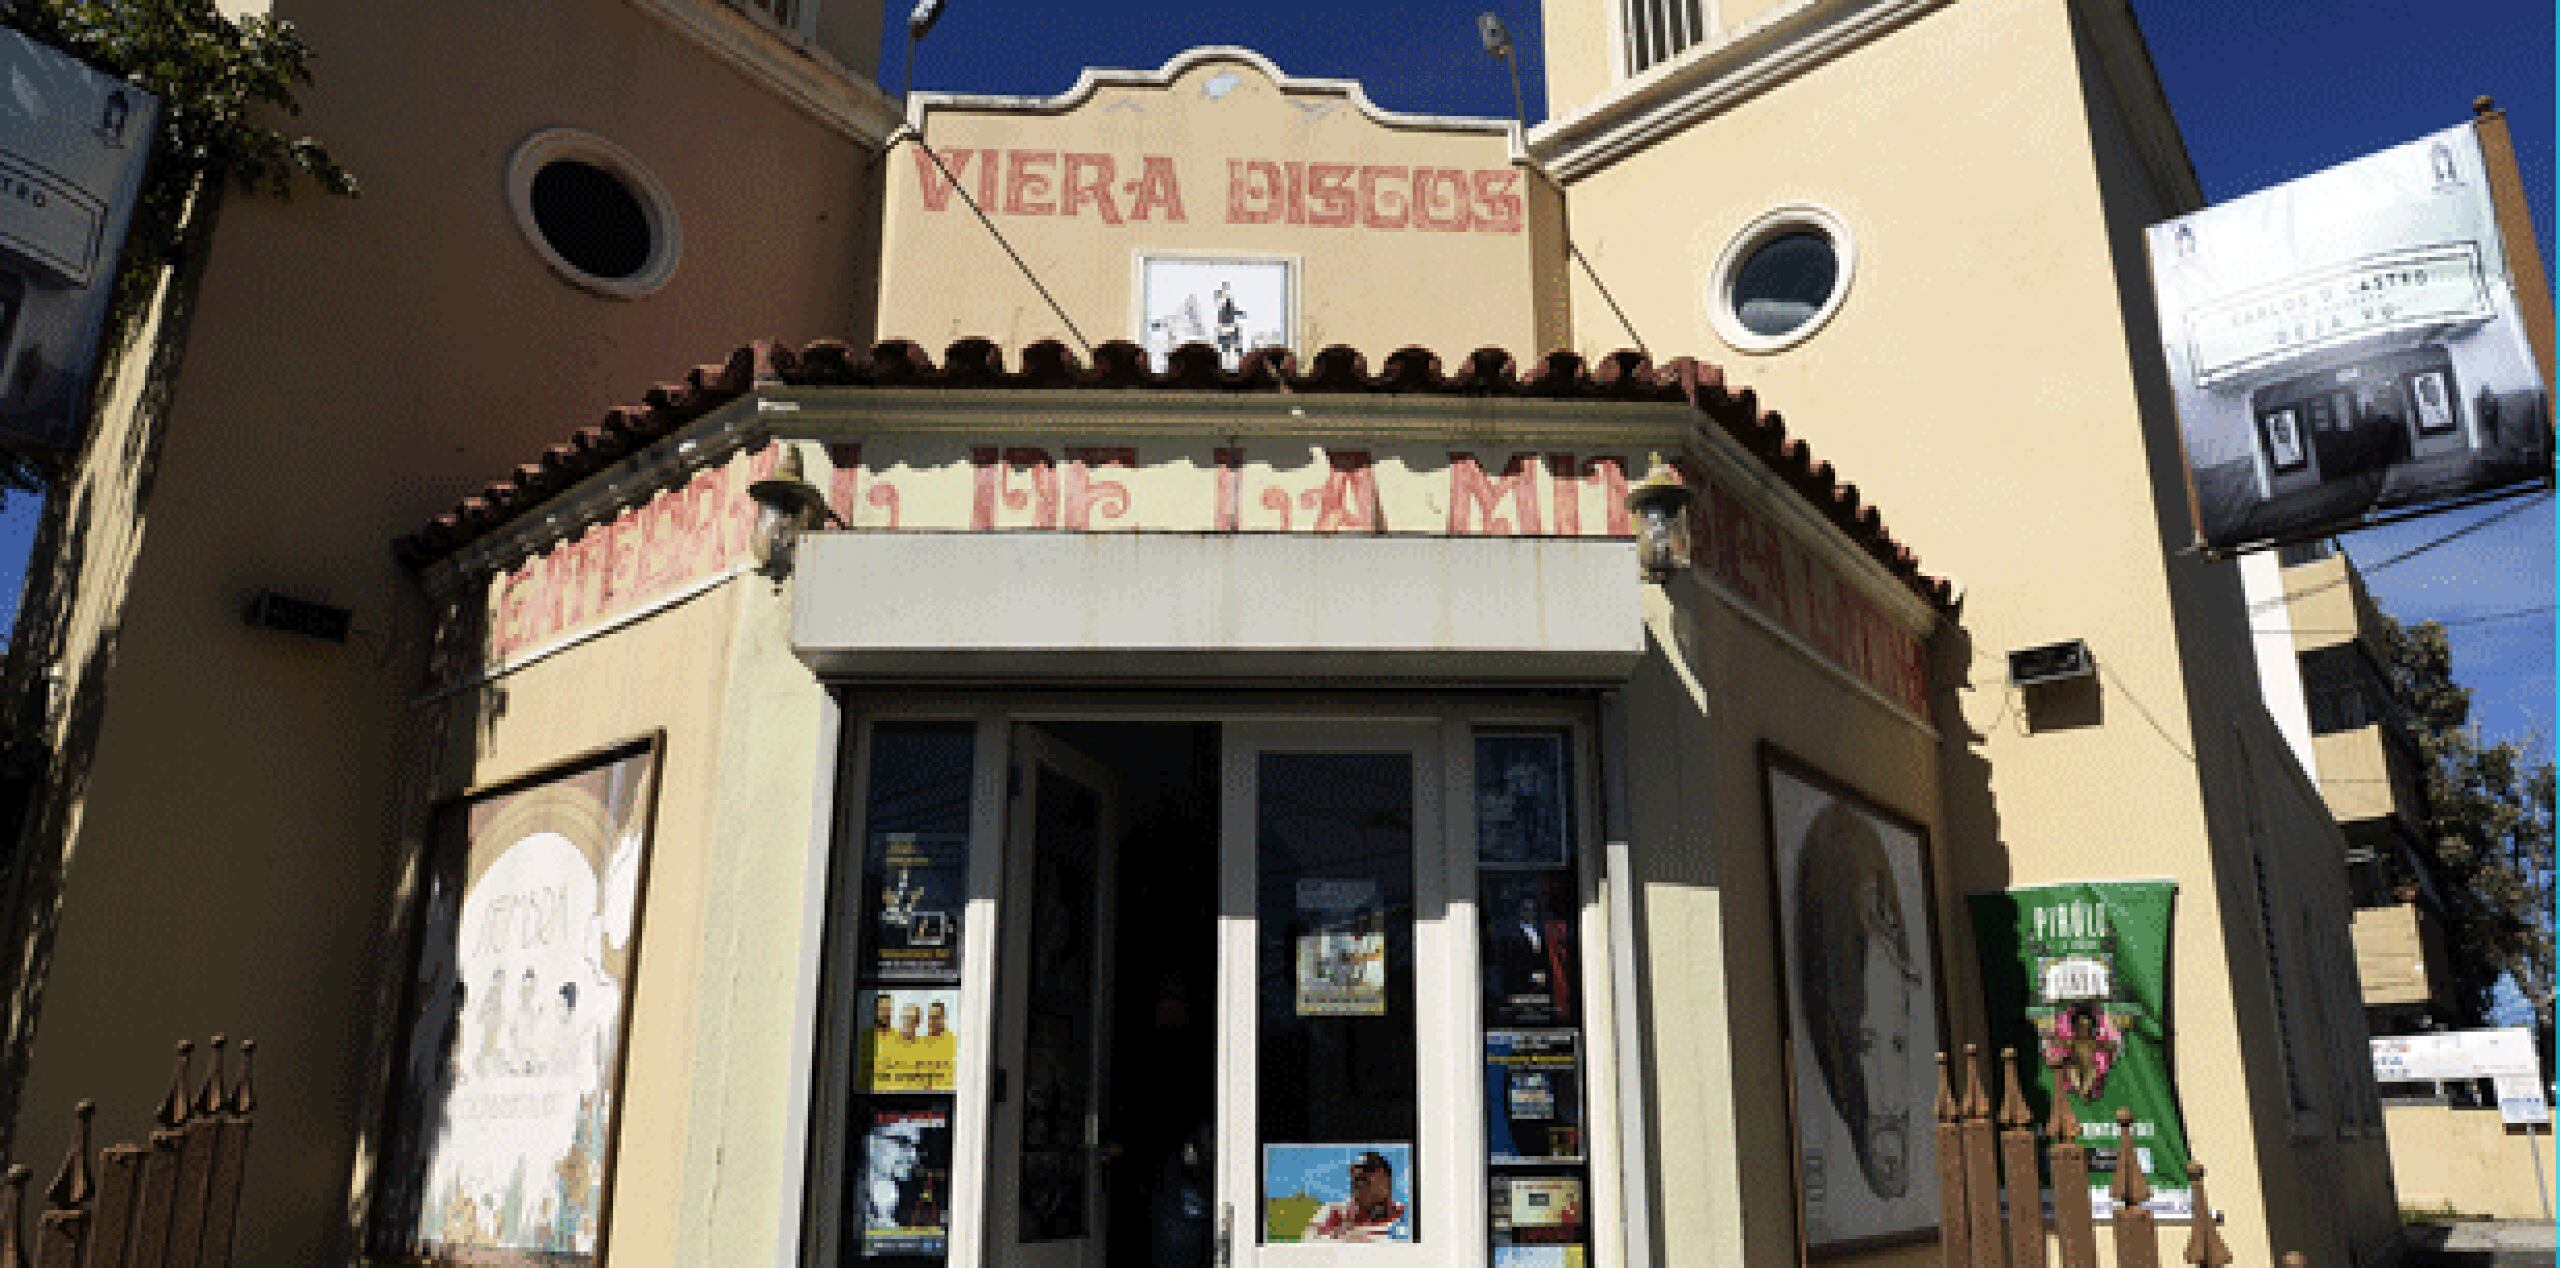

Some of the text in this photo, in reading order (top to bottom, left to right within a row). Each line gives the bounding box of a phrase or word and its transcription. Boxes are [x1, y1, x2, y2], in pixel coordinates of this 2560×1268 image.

[912, 147, 1522, 235] VIERA DISCOS
[2231, 293, 2309, 327] CARLOS
[2345, 268, 2430, 295] CASTRO
[969, 447, 1138, 530] DE
[1213, 447, 1378, 532] LA
